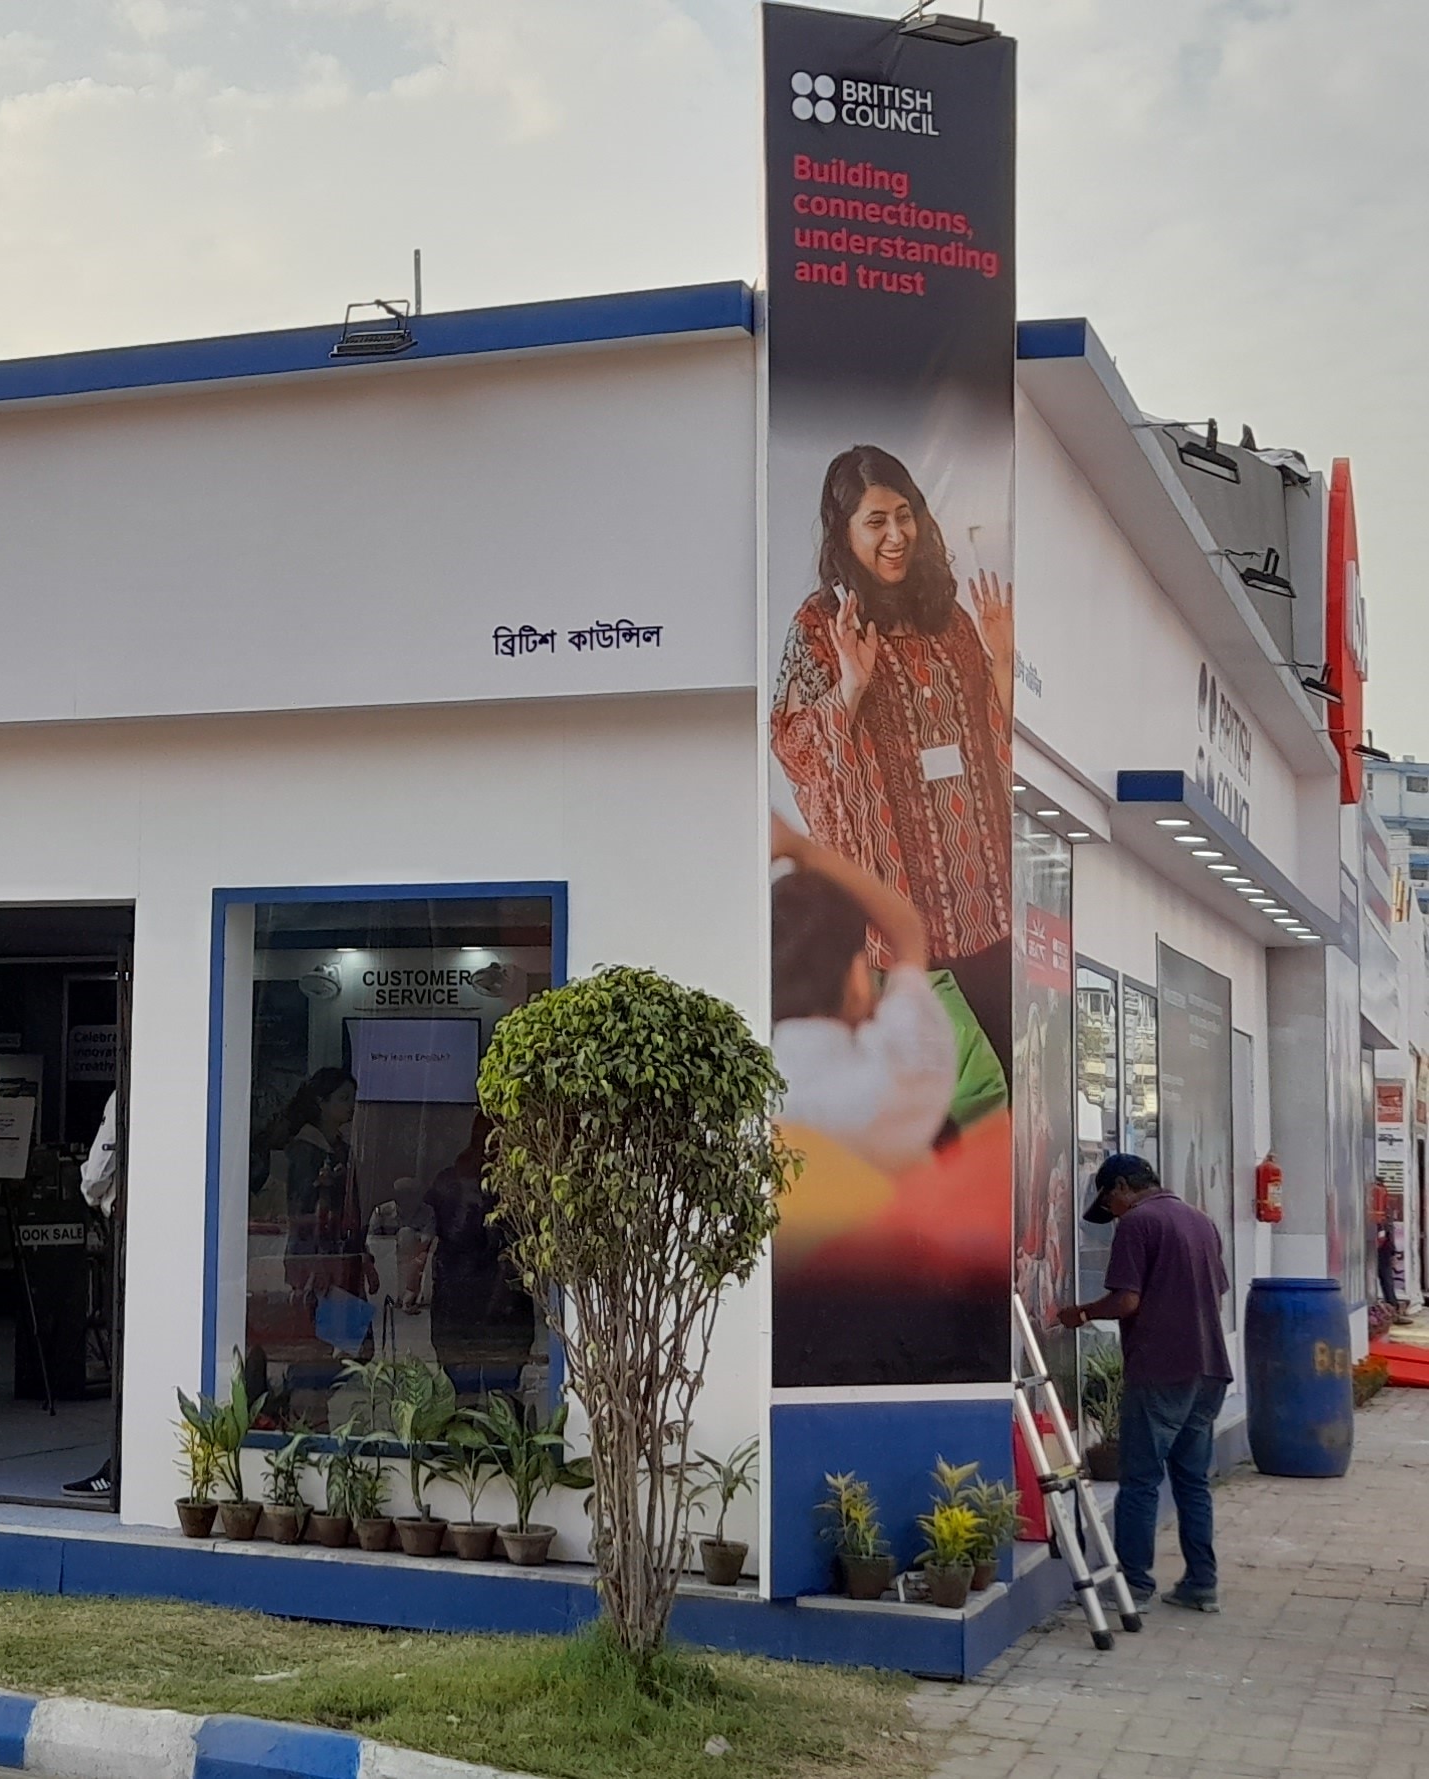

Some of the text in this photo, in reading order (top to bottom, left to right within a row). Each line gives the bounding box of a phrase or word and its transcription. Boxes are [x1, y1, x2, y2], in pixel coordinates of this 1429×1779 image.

[842, 80, 932, 112] BRITISH
[841, 103, 939, 136] COUNCIL
[793, 154, 909, 198] Building
[793, 193, 974, 240] connections,
[794, 227, 999, 278] understanding
[794, 261, 926, 296] and trust
[492, 619, 663, 657] ব্রিটিশ কাউন্সিল
[362, 970, 472, 986] CUSTOMER
[376, 988, 459, 1005] SERVICE
[21, 1226, 83, 1242] OOK SALE
